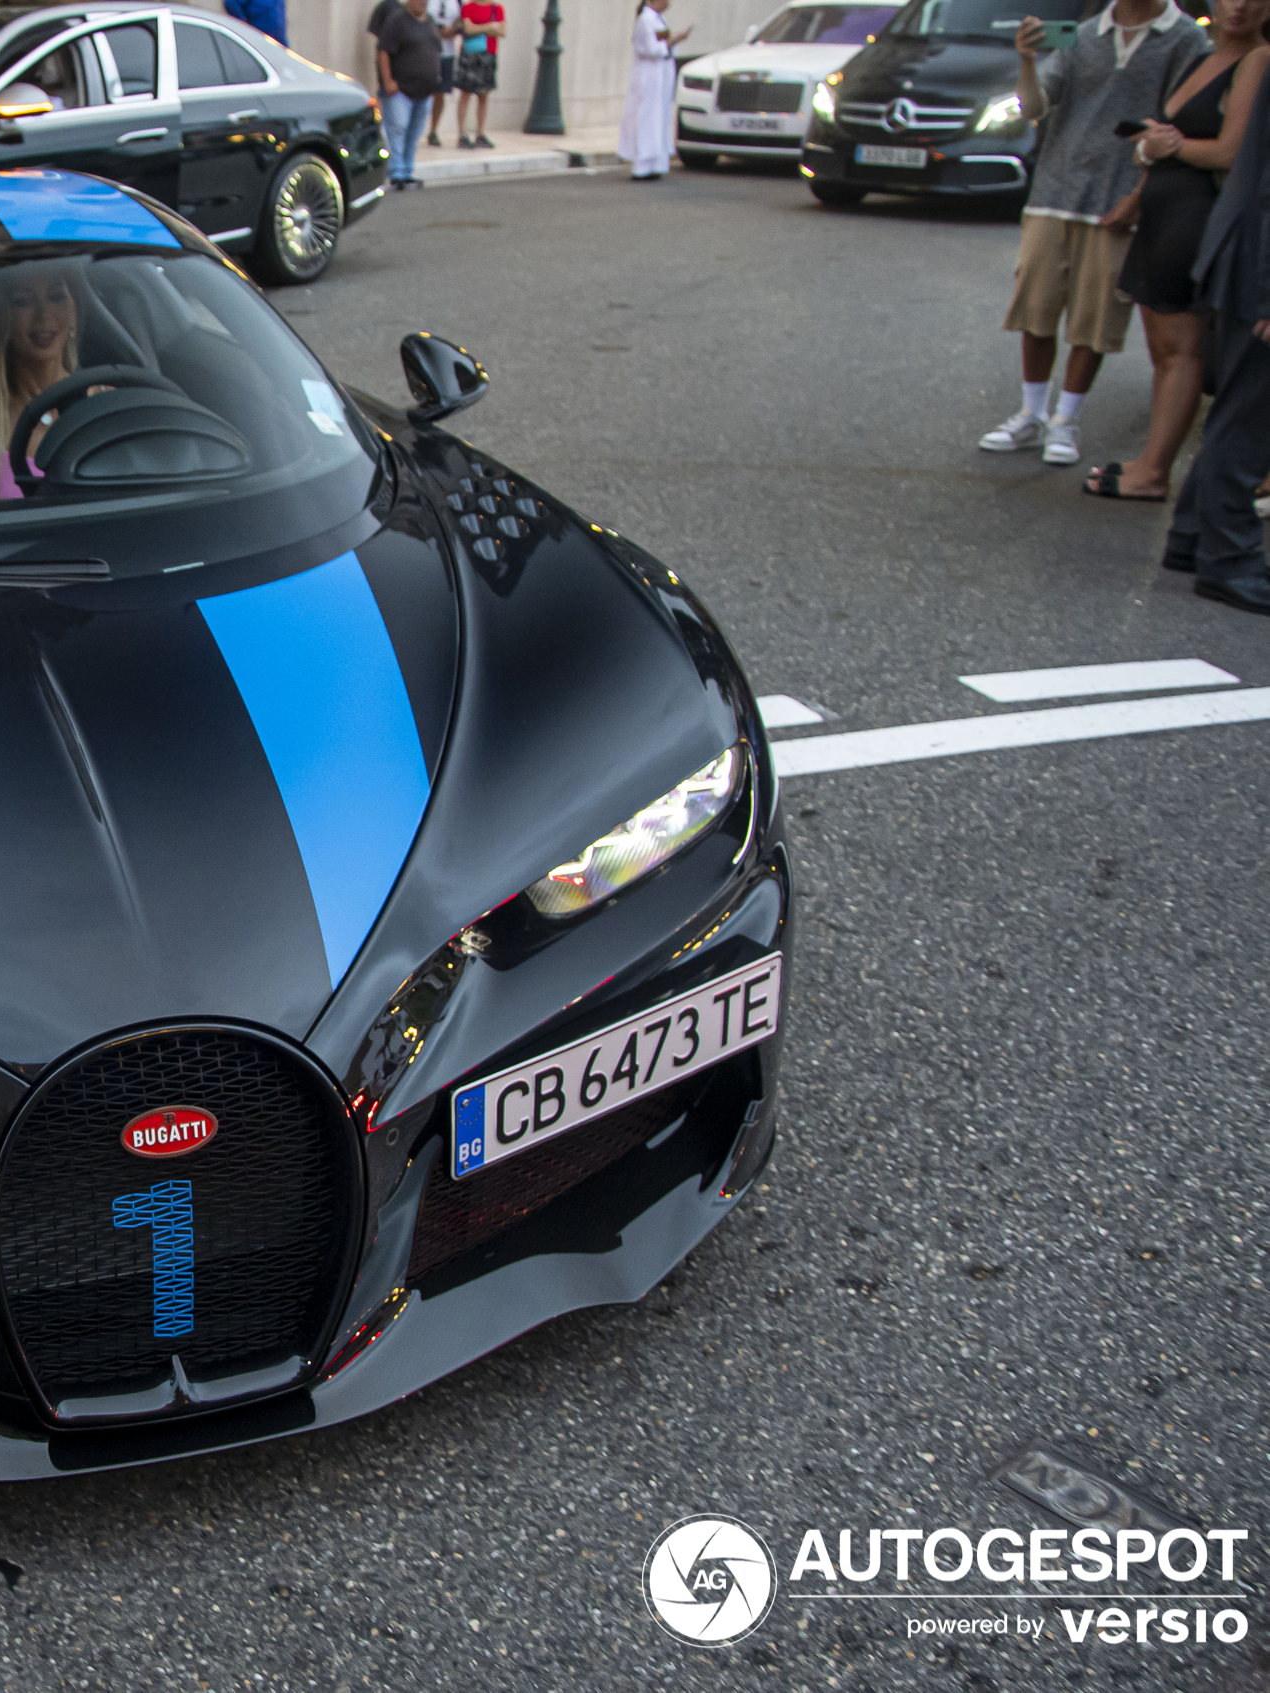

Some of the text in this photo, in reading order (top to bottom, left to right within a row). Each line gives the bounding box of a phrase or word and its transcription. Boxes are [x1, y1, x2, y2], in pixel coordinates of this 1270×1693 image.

[496, 968, 772, 1145] CB 6473 TE
[132, 1119, 207, 1148] BUGATTI
[459, 1137, 482, 1163] BG
[112, 1180, 194, 1337] 1
